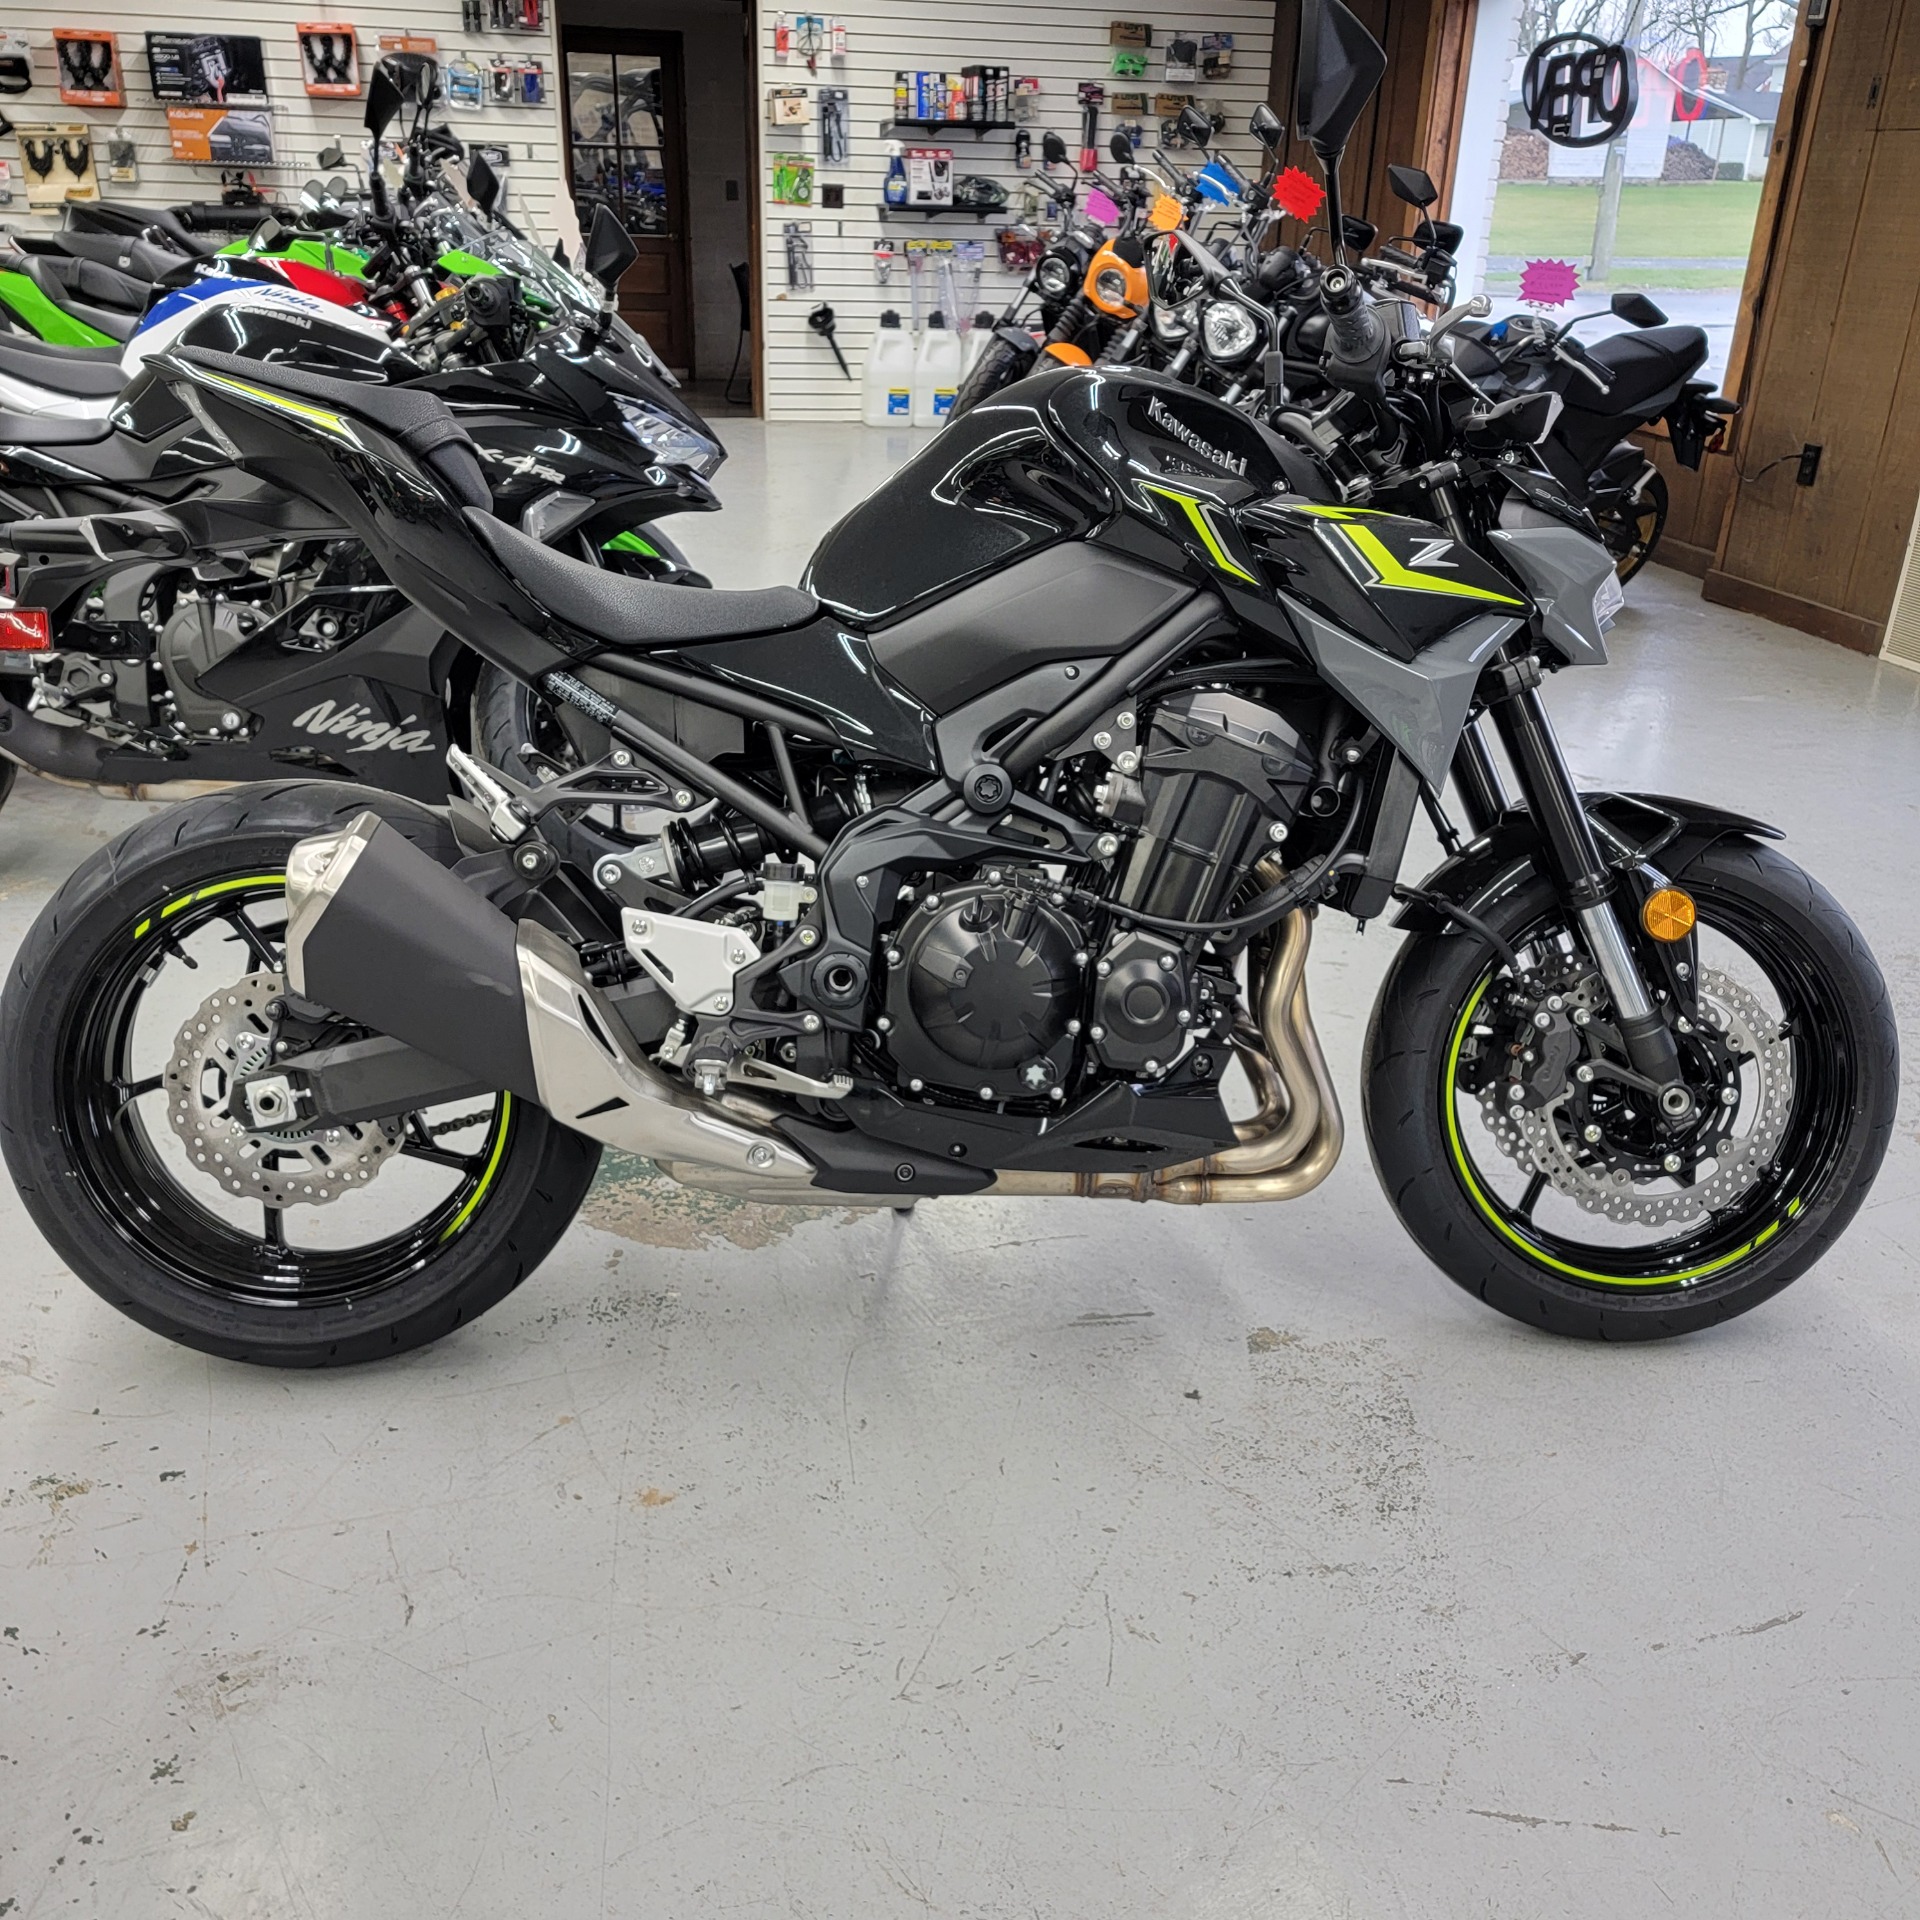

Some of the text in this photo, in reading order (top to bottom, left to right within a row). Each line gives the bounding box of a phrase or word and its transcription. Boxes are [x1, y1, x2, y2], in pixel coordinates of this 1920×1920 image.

[254, 287, 324, 313] Ninja
[1147, 395, 1248, 477] Kawasaki
[1535, 488, 1583, 516] 900
[1408, 537, 1460, 567] Z
[291, 699, 436, 753] Ninja
